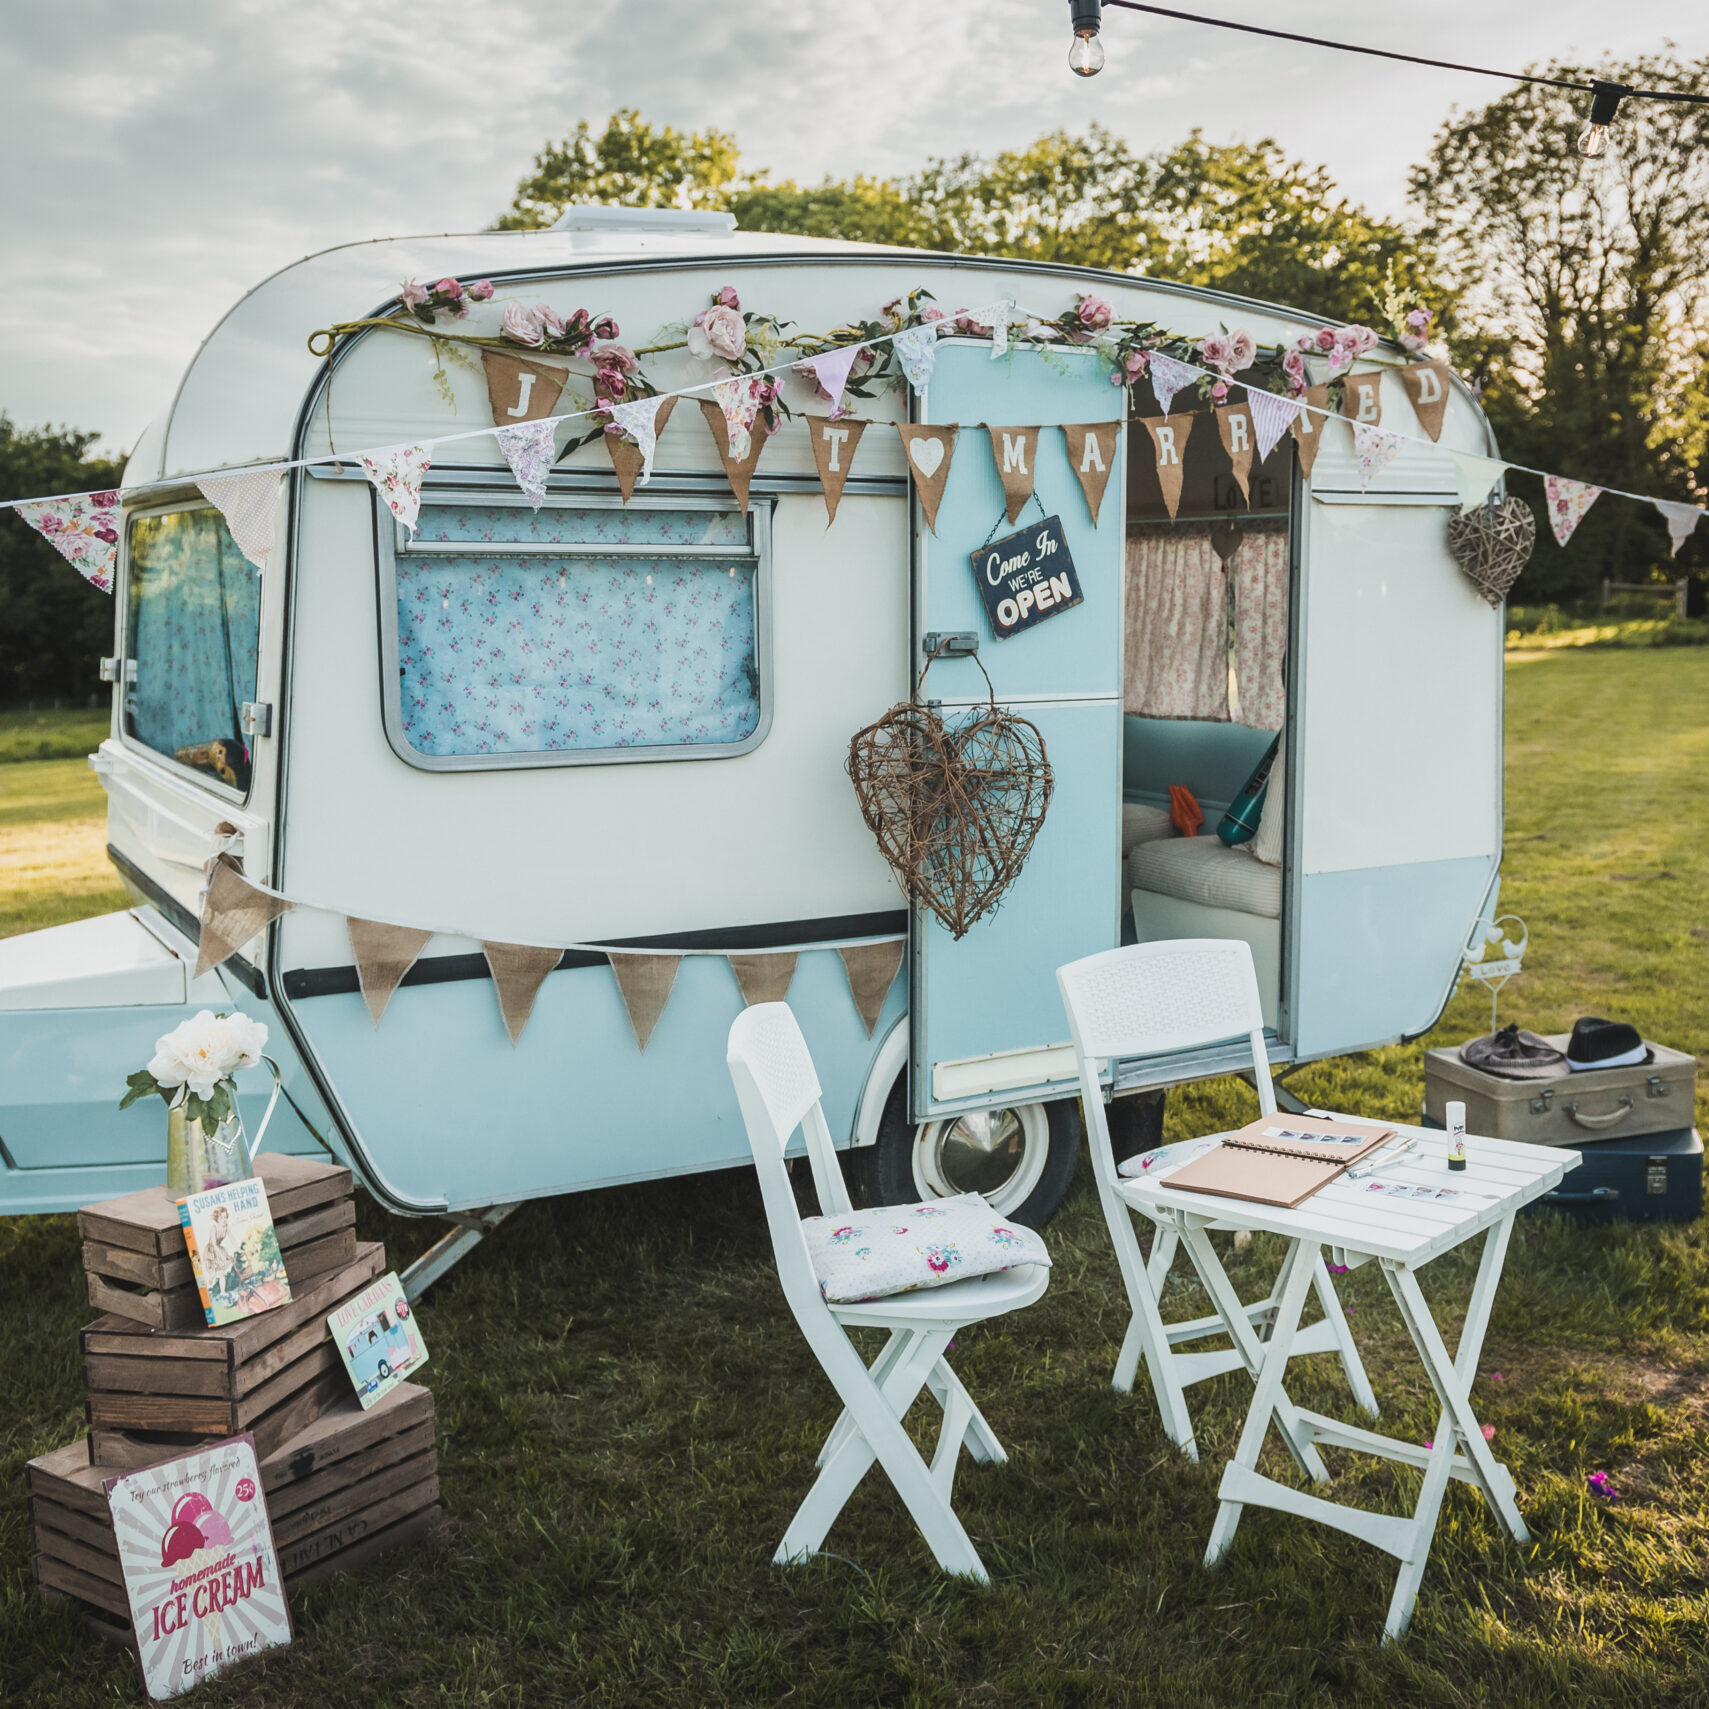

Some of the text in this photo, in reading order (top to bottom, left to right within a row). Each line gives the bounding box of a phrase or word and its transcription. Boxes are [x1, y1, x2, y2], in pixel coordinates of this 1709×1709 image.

[1002, 367, 1442, 475] MARRIED
[986, 529, 1058, 586] Come In
[996, 571, 1073, 628] OPEN
[1007, 566, 1044, 592] WE'RE
[193, 1191, 226, 1214] SUSAN'S
[227, 1183, 260, 1201] HELPING
[233, 1196, 259, 1213] HAND
[130, 1489, 144, 1503] Try
[146, 1486, 160, 1495] our
[162, 1472, 207, 1492] strawberry
[170, 1553, 236, 1595] homemade
[152, 1556, 265, 1641] ICE CREAM
[182, 1632, 258, 1674] Best in town!
